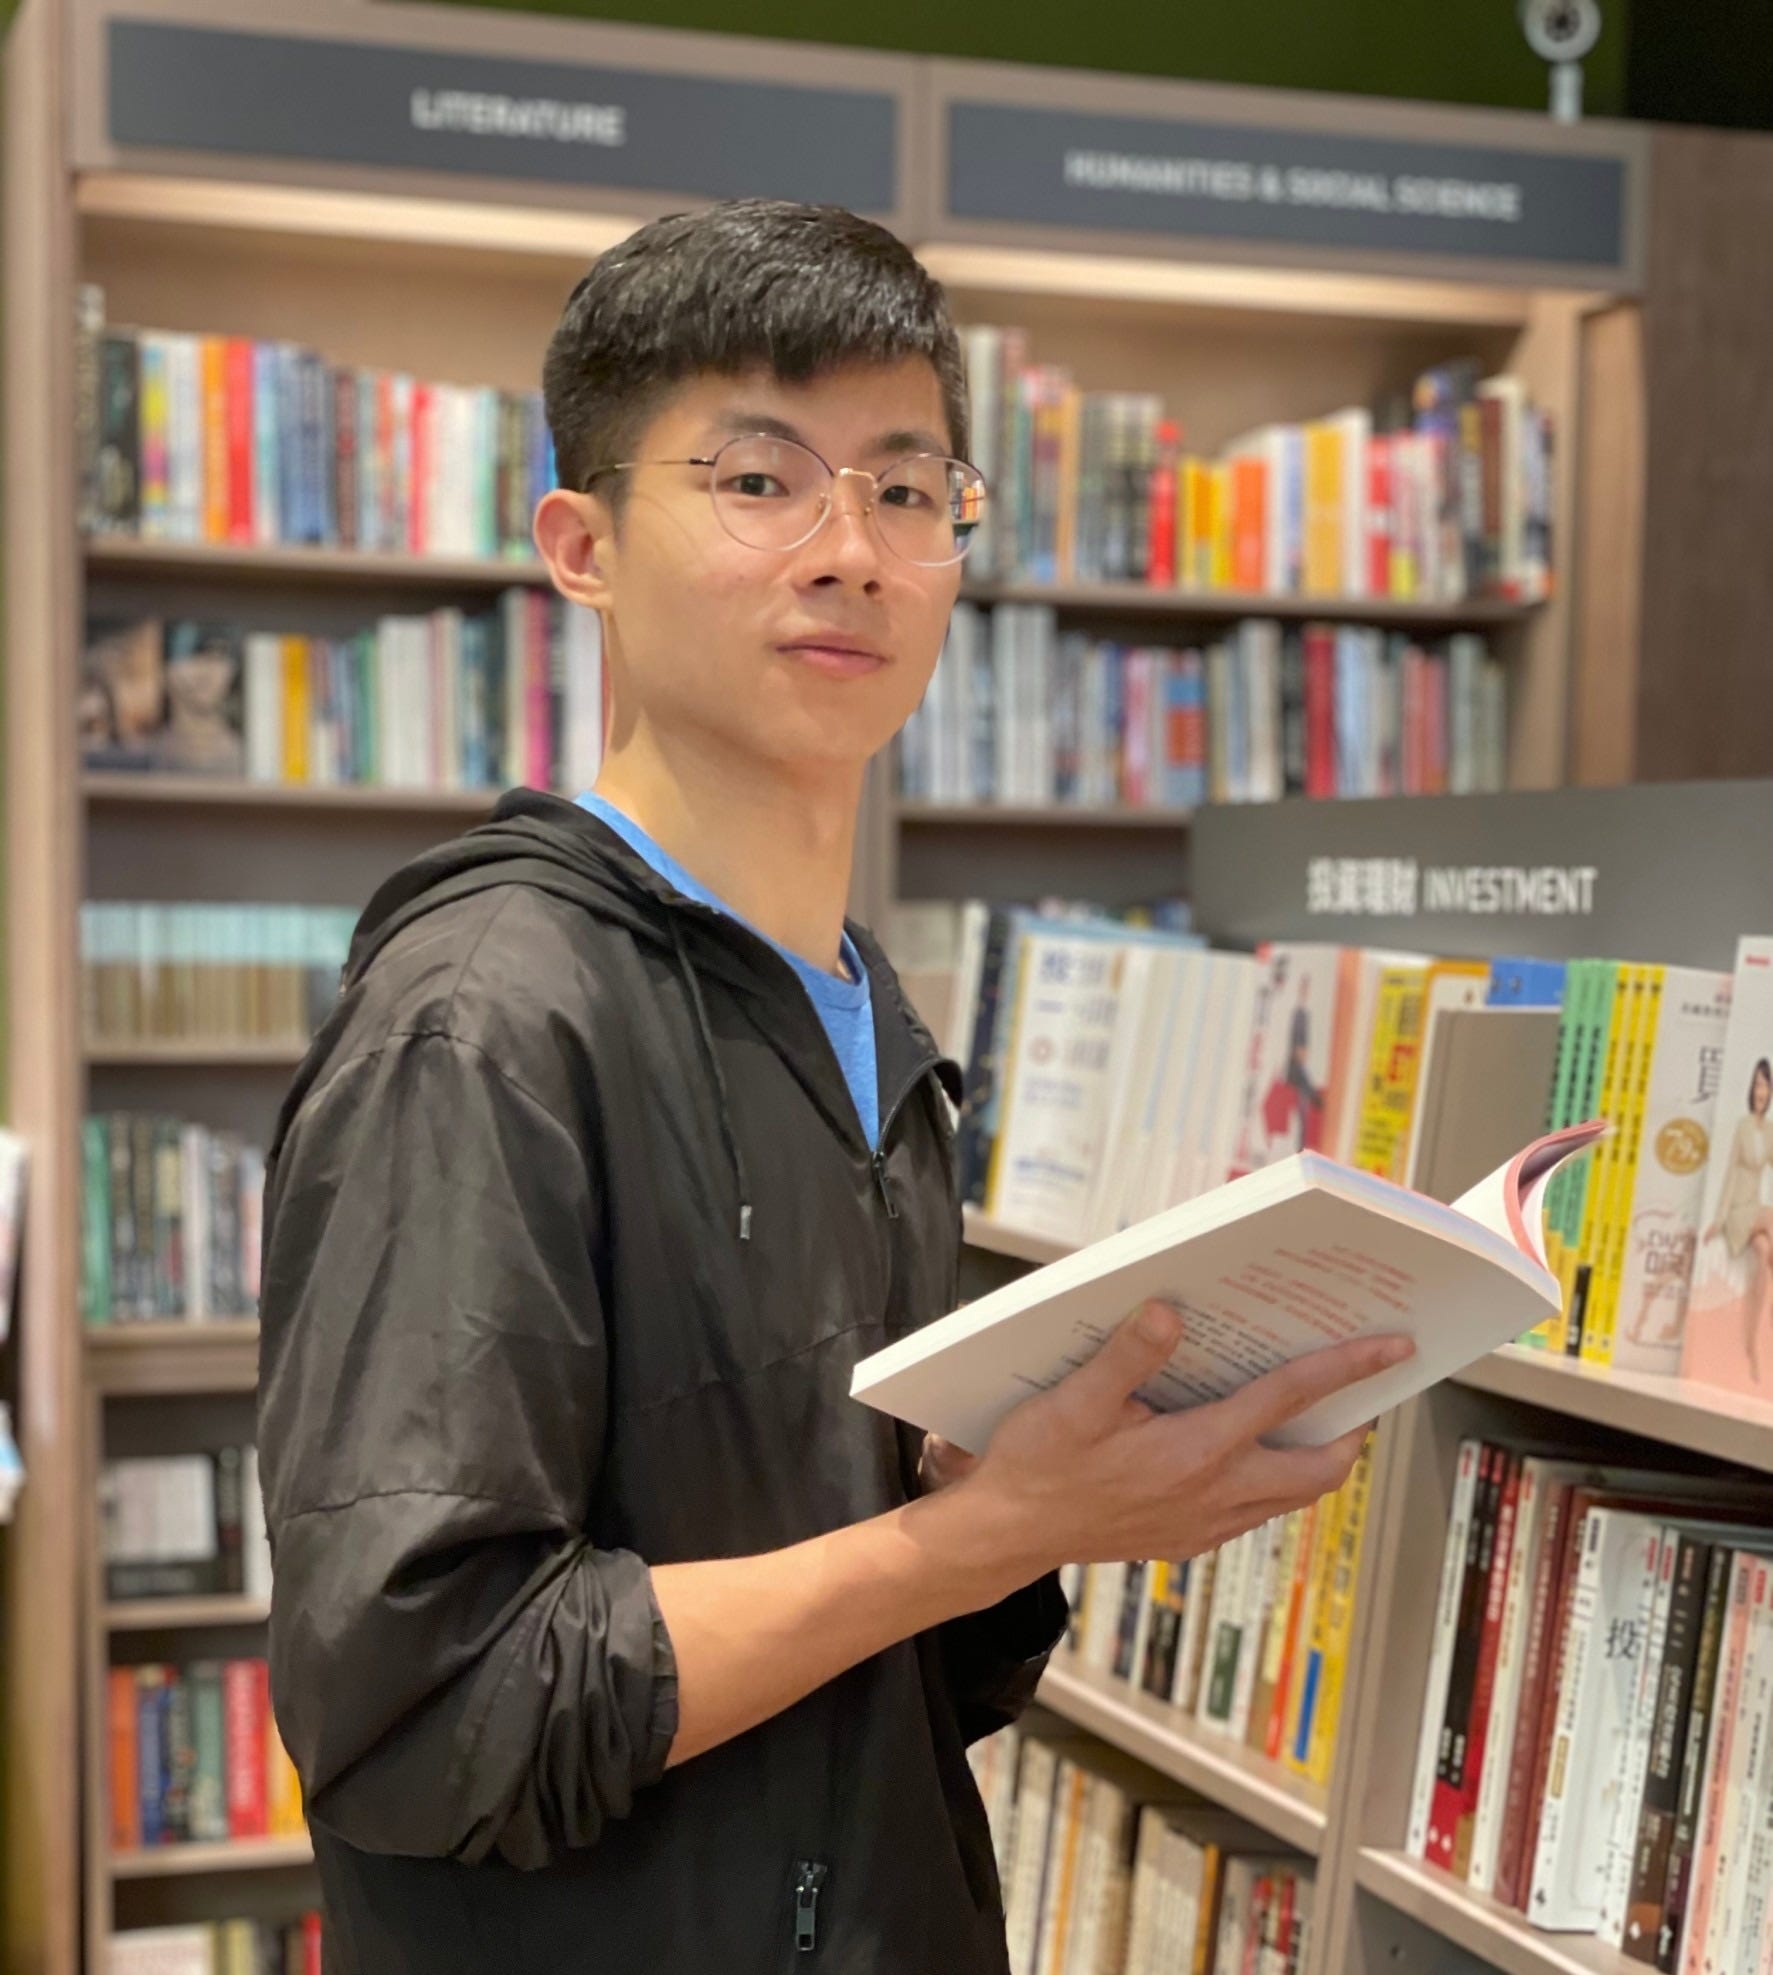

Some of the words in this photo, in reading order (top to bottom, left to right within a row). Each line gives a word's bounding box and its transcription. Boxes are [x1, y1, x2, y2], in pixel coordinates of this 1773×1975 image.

[410, 87, 626, 147] LITERATURE
[1064, 148, 1254, 201] HUMANITIES
[1258, 164, 1281, 202] &
[1284, 166, 1389, 213] SOCIAL
[1393, 174, 1523, 223] SCIENCE
[1422, 865, 1598, 914] INVESTMENT
